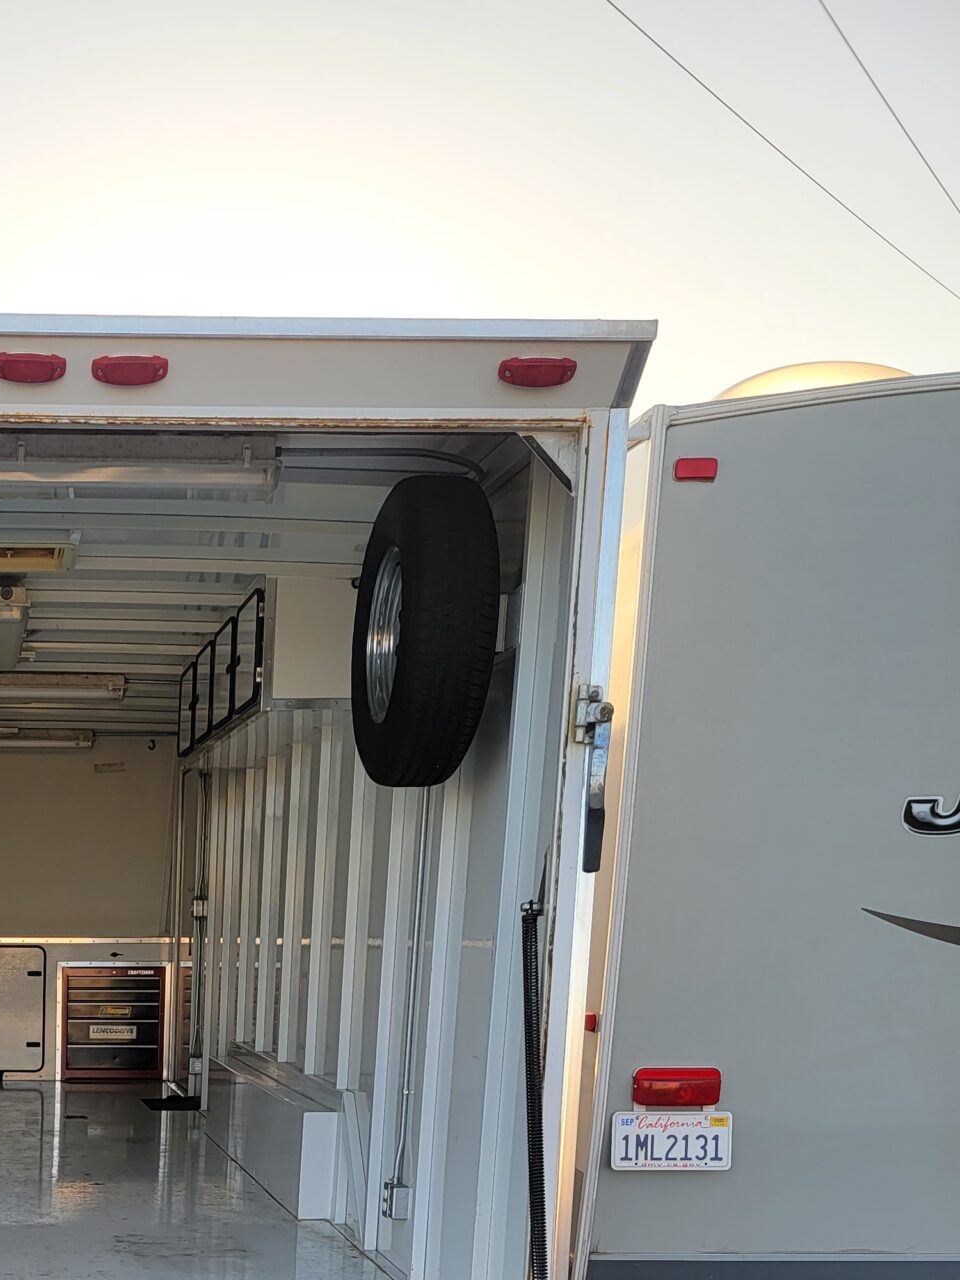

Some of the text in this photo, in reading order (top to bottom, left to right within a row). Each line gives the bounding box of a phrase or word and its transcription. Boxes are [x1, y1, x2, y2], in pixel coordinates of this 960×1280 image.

[620, 1118, 634, 1126] SEP
[637, 1115, 703, 1133] California
[619, 1134, 723, 1161] 1ML2131
